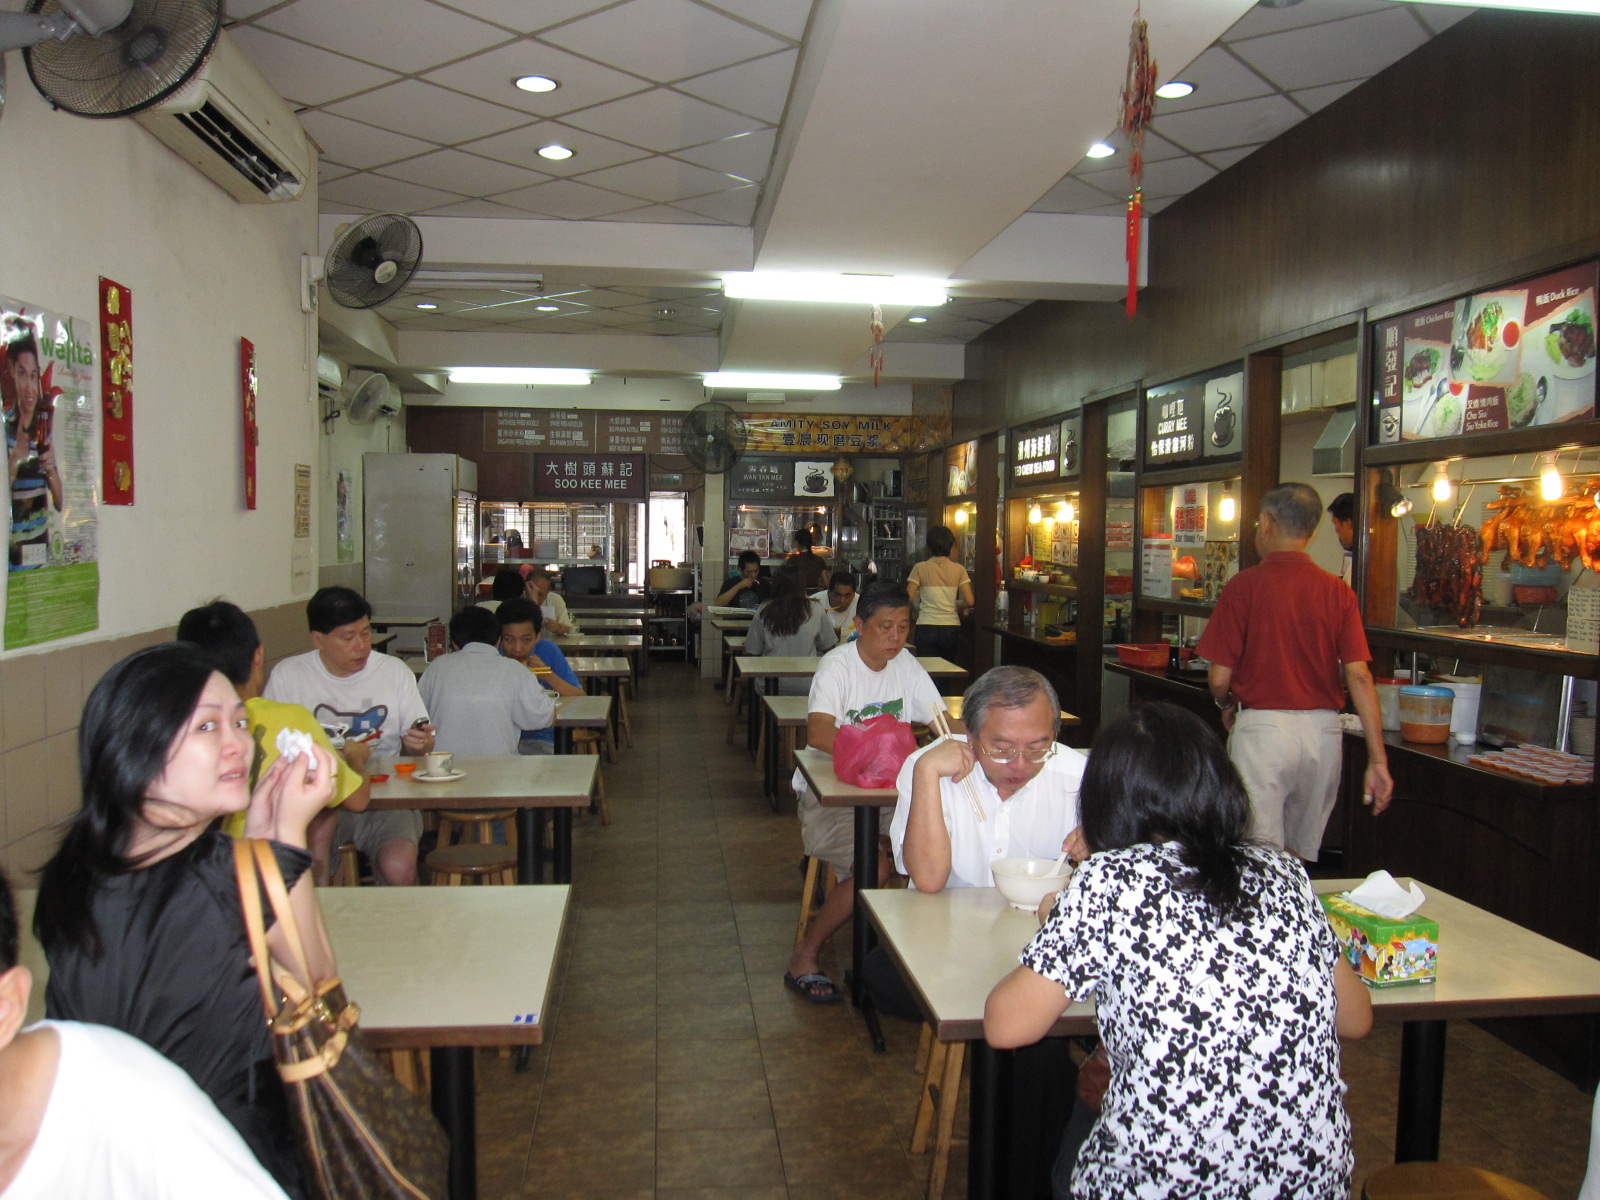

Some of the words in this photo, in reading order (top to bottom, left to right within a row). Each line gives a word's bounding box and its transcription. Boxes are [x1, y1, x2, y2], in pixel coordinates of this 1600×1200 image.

[770, 419, 814, 429] AMITY
[822, 420, 851, 430] SOY
[858, 421, 891, 431] MILK
[1158, 420, 1175, 435] CURRY
[1176, 416, 1188, 431] MEE
[546, 460, 633, 477] 大樹頭蘇記
[1033, 461, 1042, 475] SEA
[1042, 459, 1055, 473] FOOD
[554, 478, 578, 489] SOO
[580, 479, 602, 489] KEE
[604, 479, 628, 490] MEE
